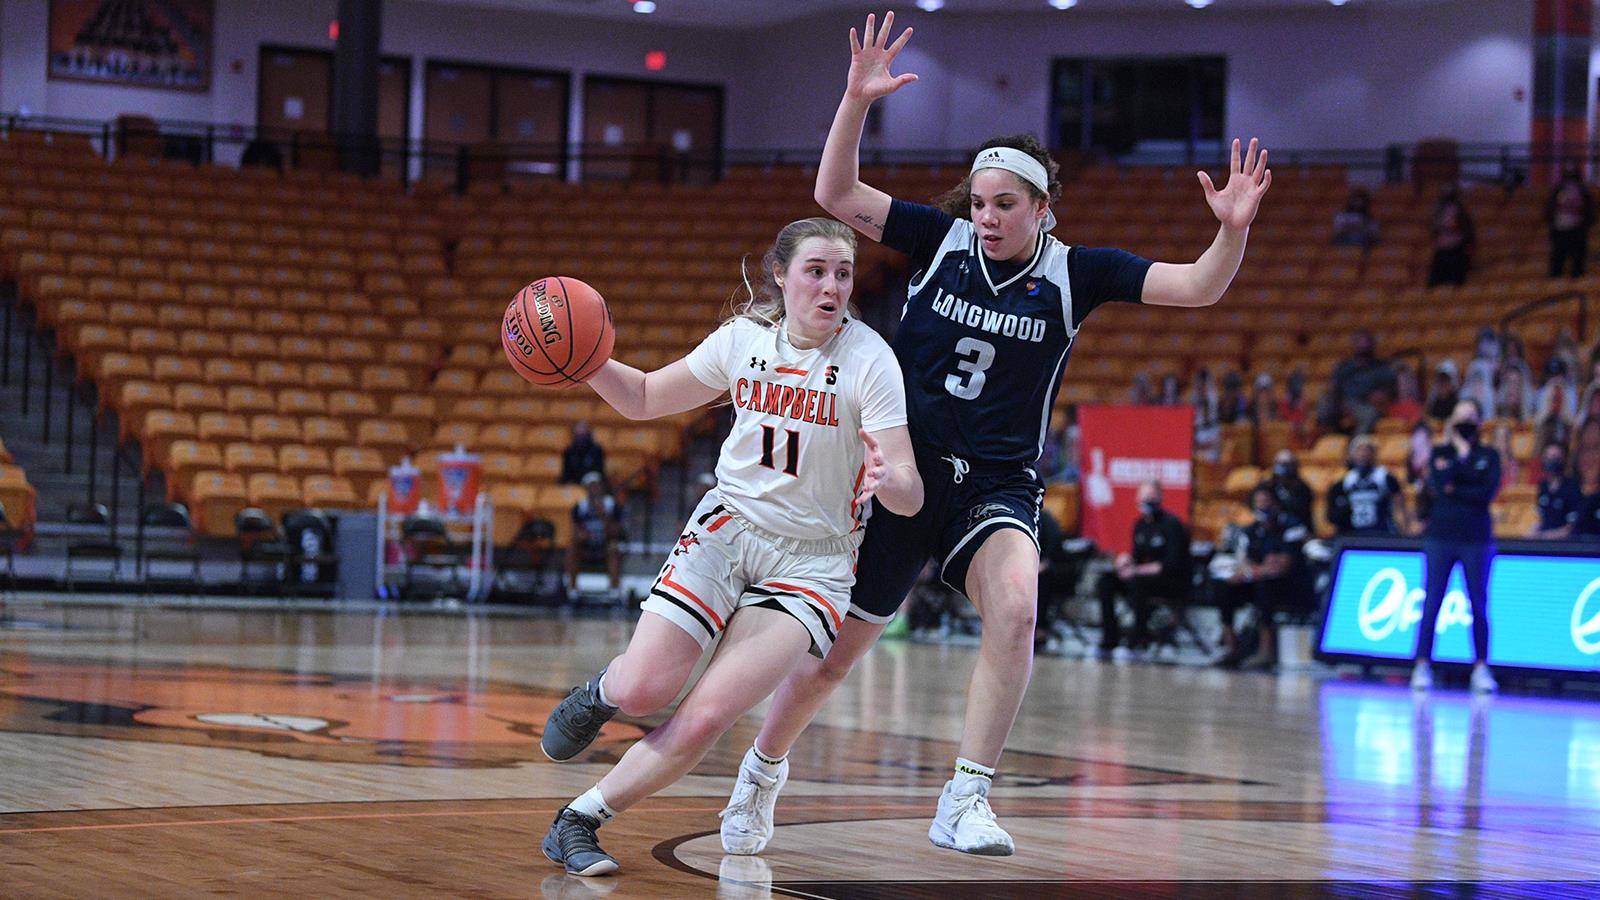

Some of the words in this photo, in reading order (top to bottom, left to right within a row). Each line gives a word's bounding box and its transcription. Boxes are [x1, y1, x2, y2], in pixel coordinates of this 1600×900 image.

[931, 287, 1047, 343] LONGWOOD
[944, 336, 996, 401] 3
[735, 377, 839, 428] CAMPBELL
[758, 423, 801, 479] 11
